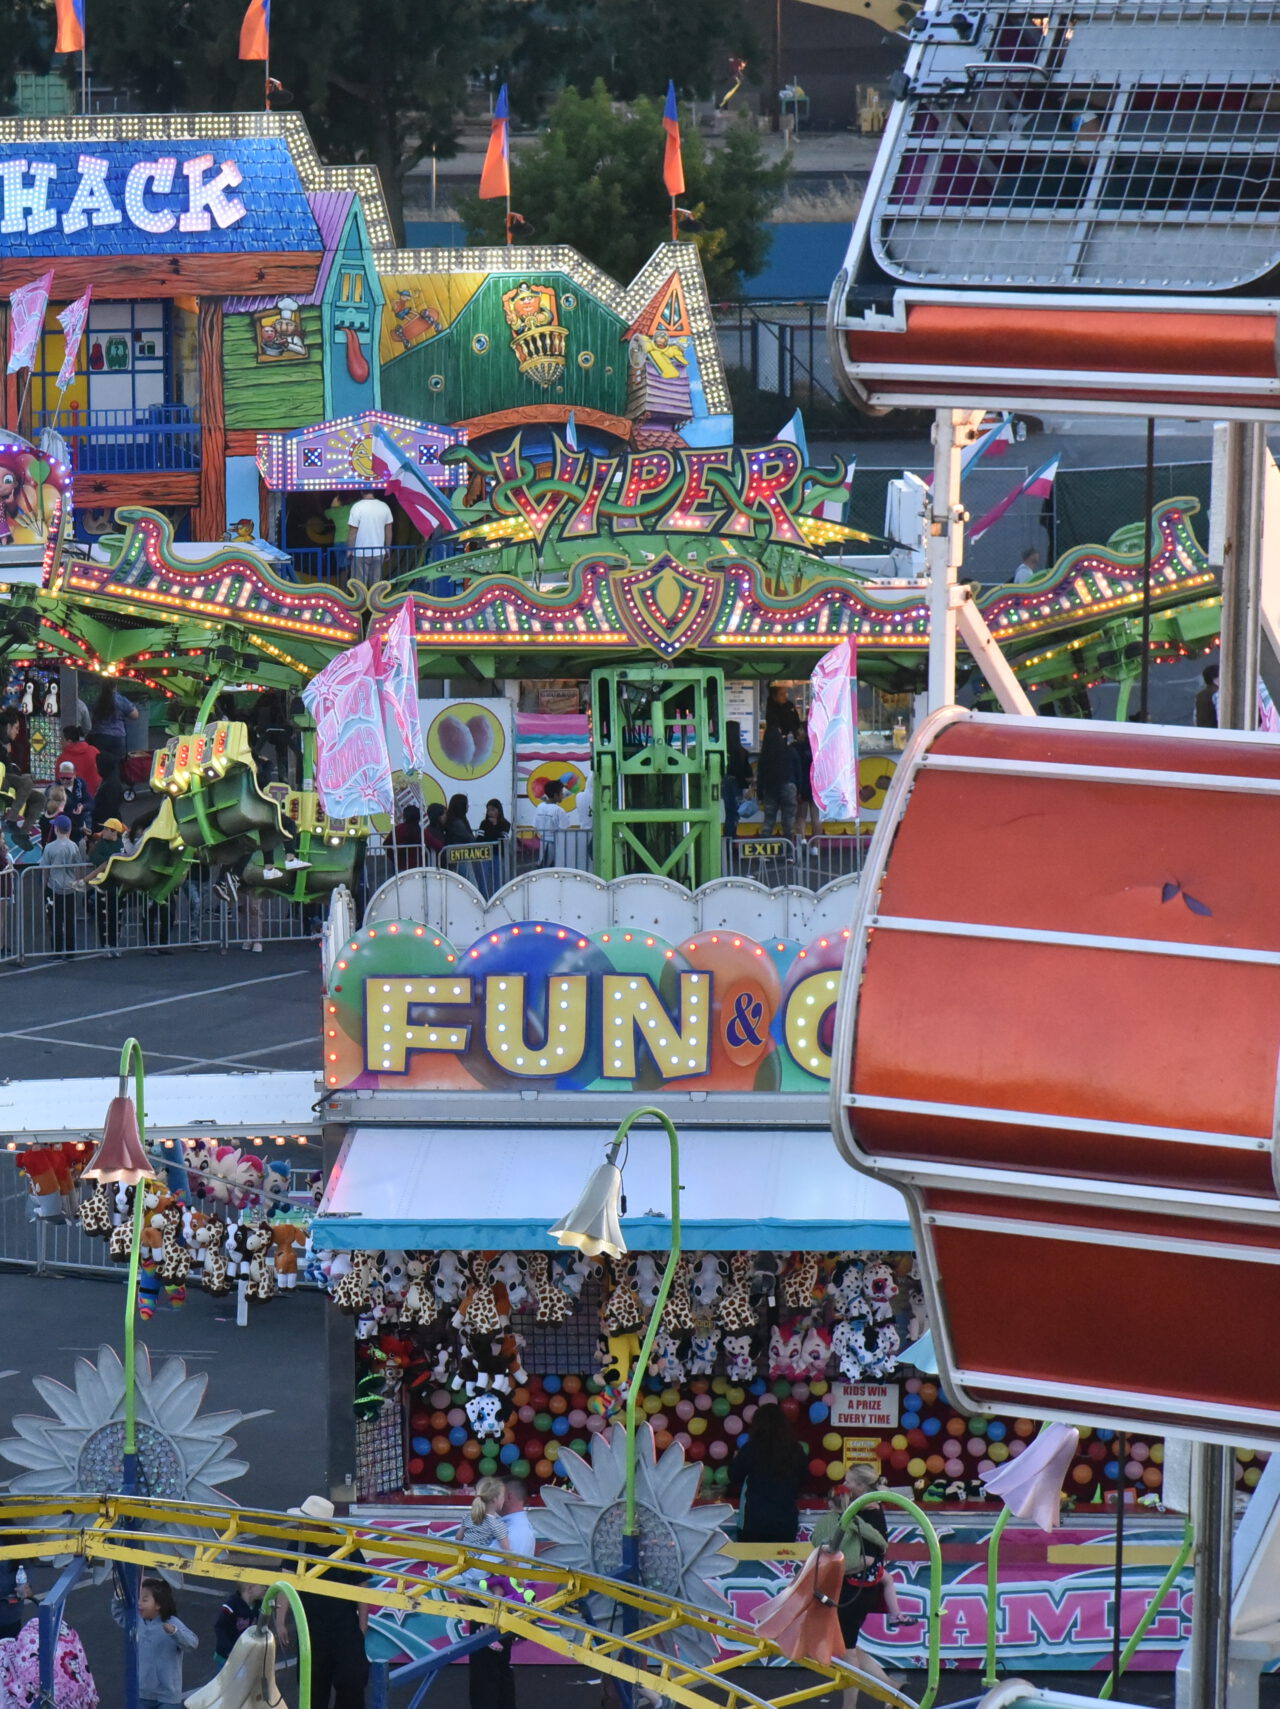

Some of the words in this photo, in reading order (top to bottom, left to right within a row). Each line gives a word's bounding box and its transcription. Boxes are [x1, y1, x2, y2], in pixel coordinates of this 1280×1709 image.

[490, 430, 815, 556] VIPER
[449, 846, 491, 861] ENTRANCE
[743, 842, 782, 857] EXIT
[363, 969, 714, 1081] FUN
[724, 991, 765, 1048] &
[843, 1386, 865, 1396] KIDS
[867, 1386, 887, 1396] WIN
[847, 1400, 854, 1410] A
[856, 1400, 881, 1410] PRIZE
[838, 1413, 866, 1423] EVERY
[868, 1414, 891, 1424] TIME
